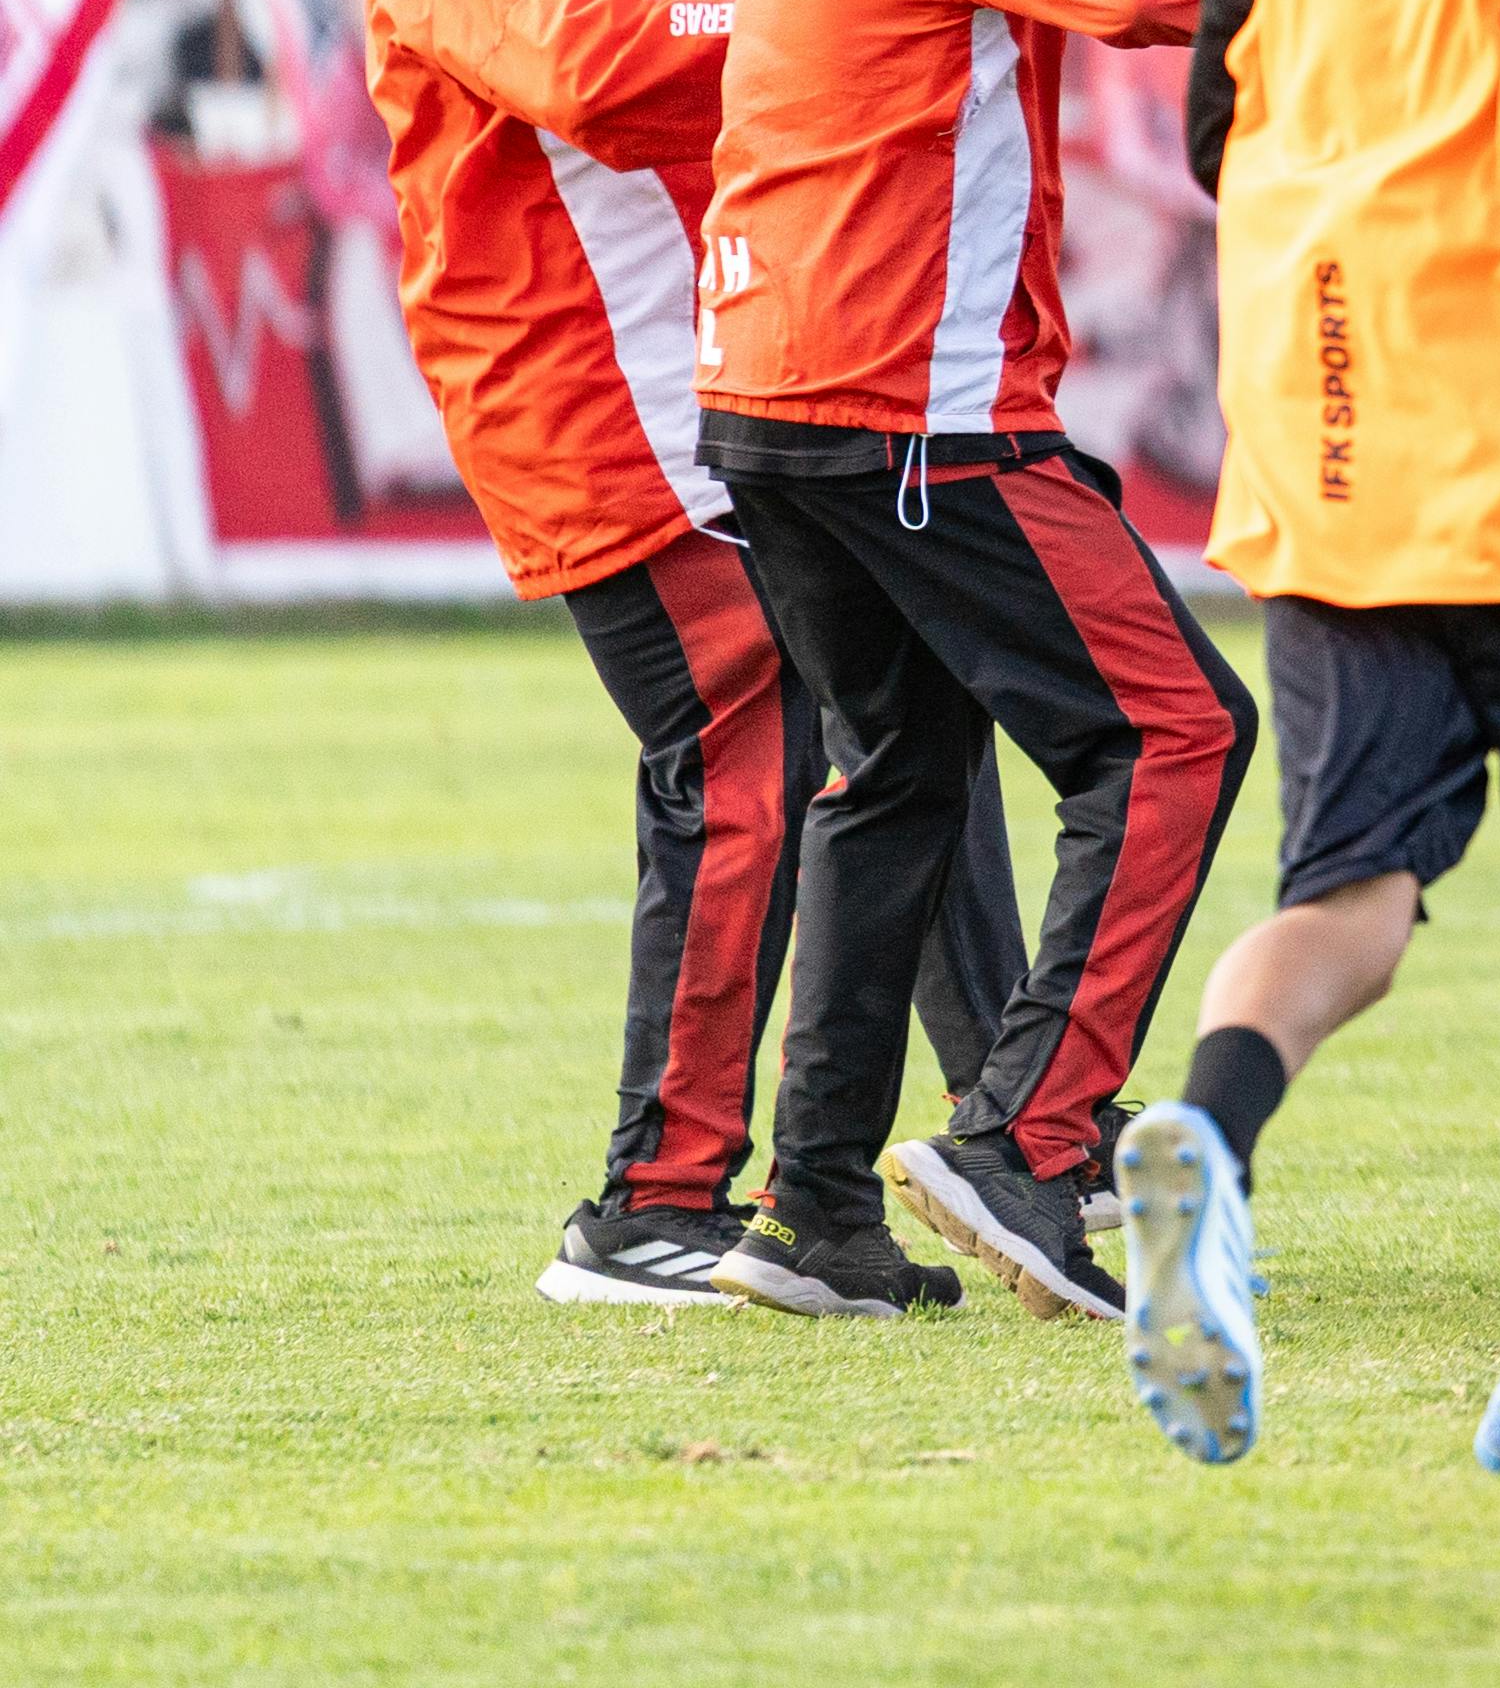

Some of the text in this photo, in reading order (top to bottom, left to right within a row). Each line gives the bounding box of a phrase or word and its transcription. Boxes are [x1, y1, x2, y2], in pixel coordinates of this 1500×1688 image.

[669, 2, 735, 38] ERAS
[1316, 261, 1356, 502] IFK SPORTS
